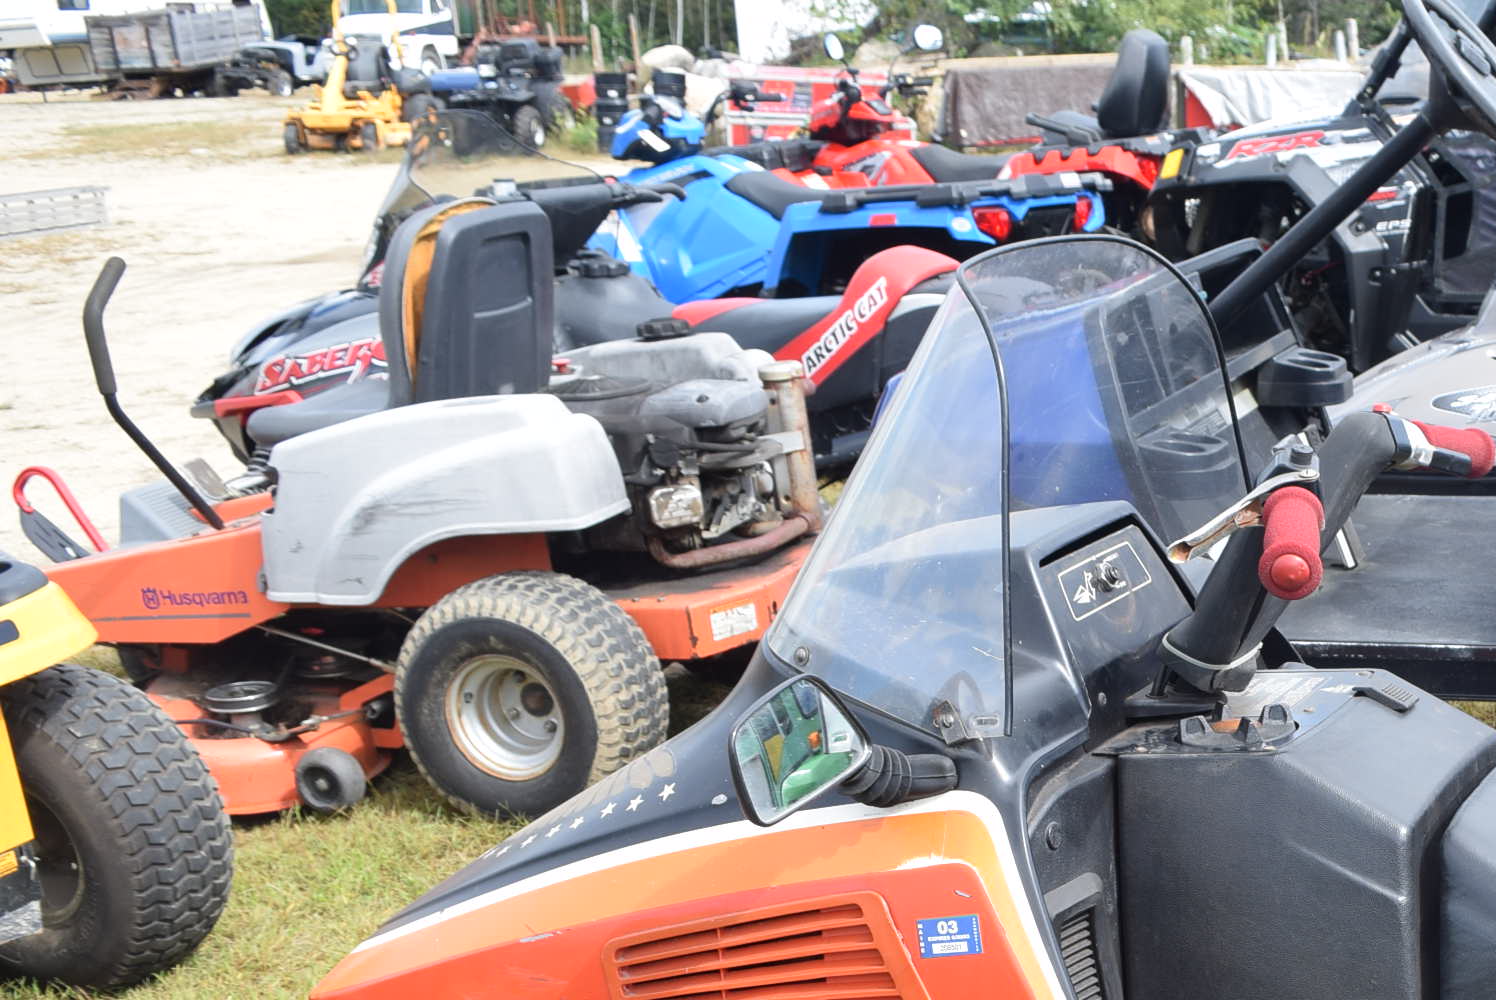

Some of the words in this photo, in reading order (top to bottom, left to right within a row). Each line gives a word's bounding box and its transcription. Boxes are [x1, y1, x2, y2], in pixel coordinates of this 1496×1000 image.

[1226, 130, 1326, 160] RZR
[805, 313, 855, 373] ARCTIC
[857, 280, 886, 320] CAT
[160, 589, 249, 608] Husqvarna
[936, 919, 959, 935] 03
